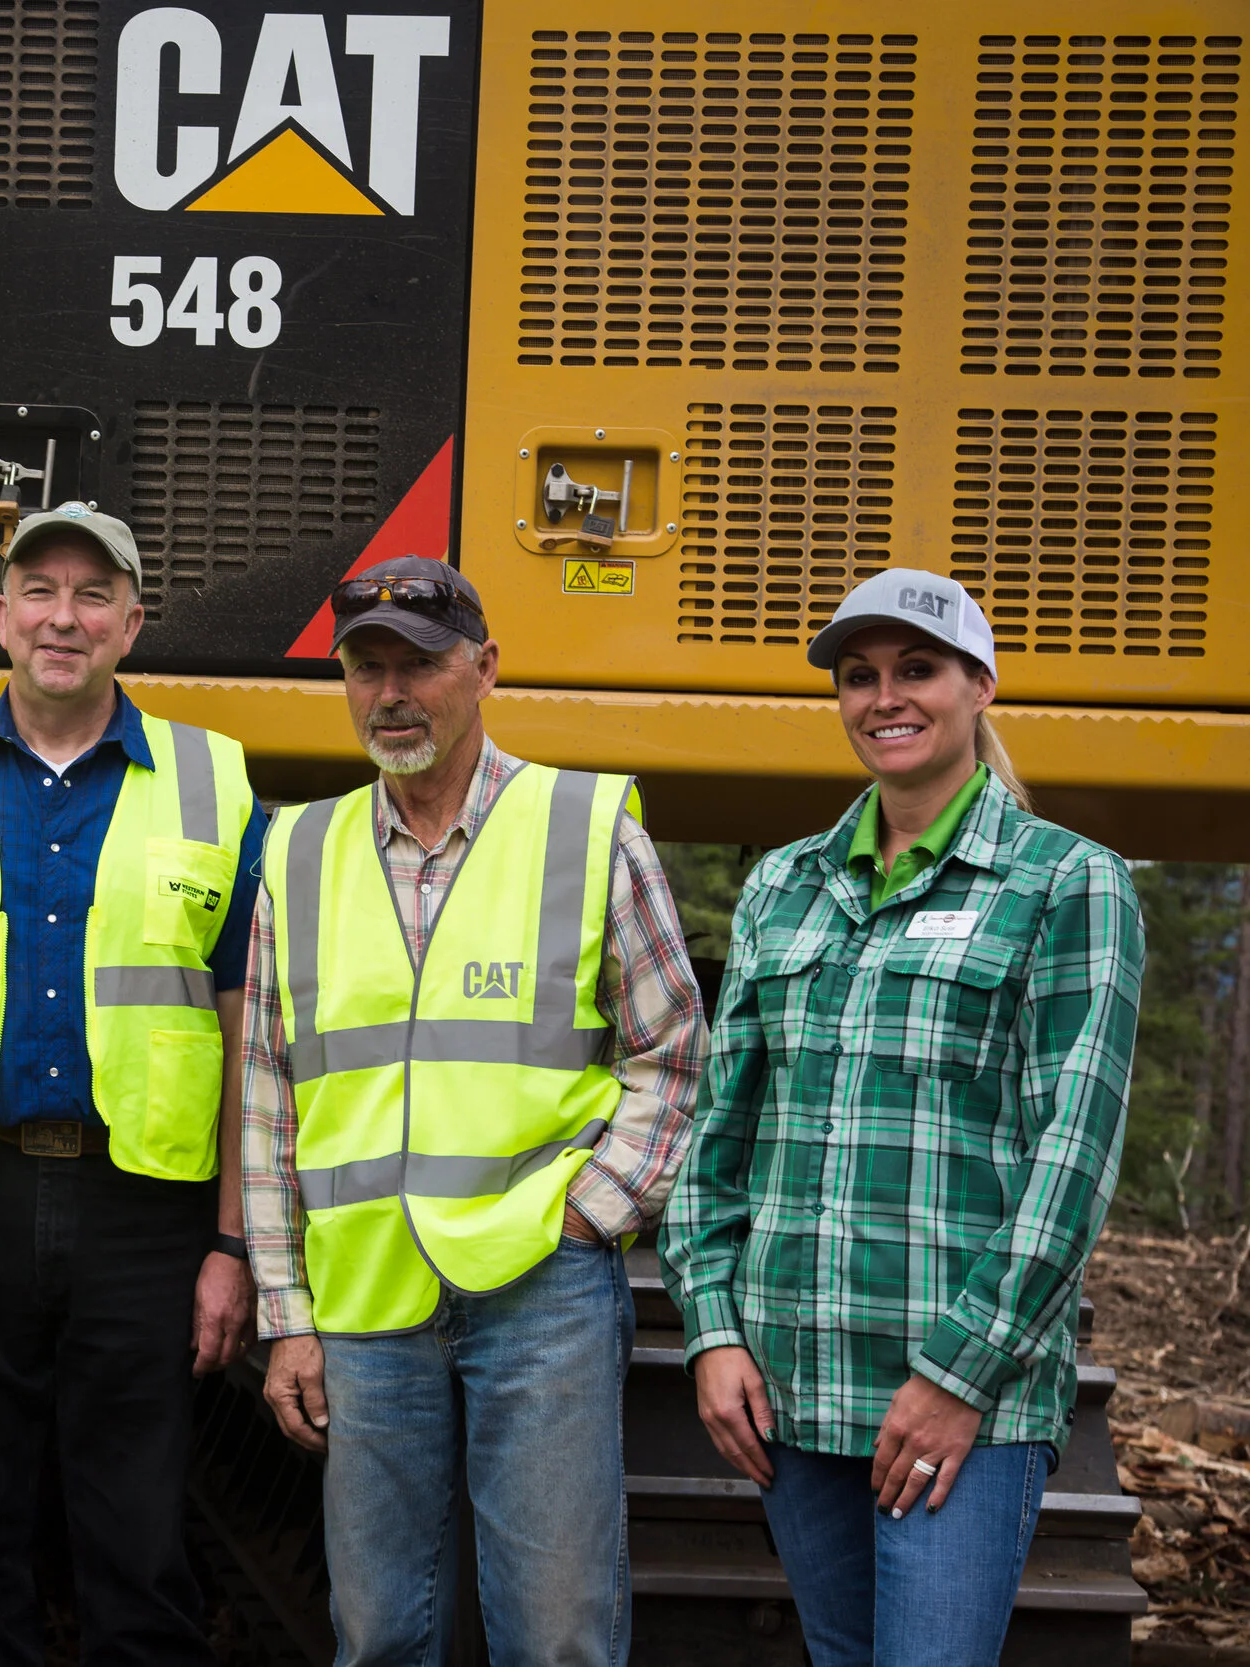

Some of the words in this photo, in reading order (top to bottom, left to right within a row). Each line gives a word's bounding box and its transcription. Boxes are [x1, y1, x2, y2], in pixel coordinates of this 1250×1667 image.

[114, 7, 450, 216] CAT
[110, 256, 282, 348] 548
[898, 587, 949, 620] CAT
[463, 961, 524, 999] CAT
